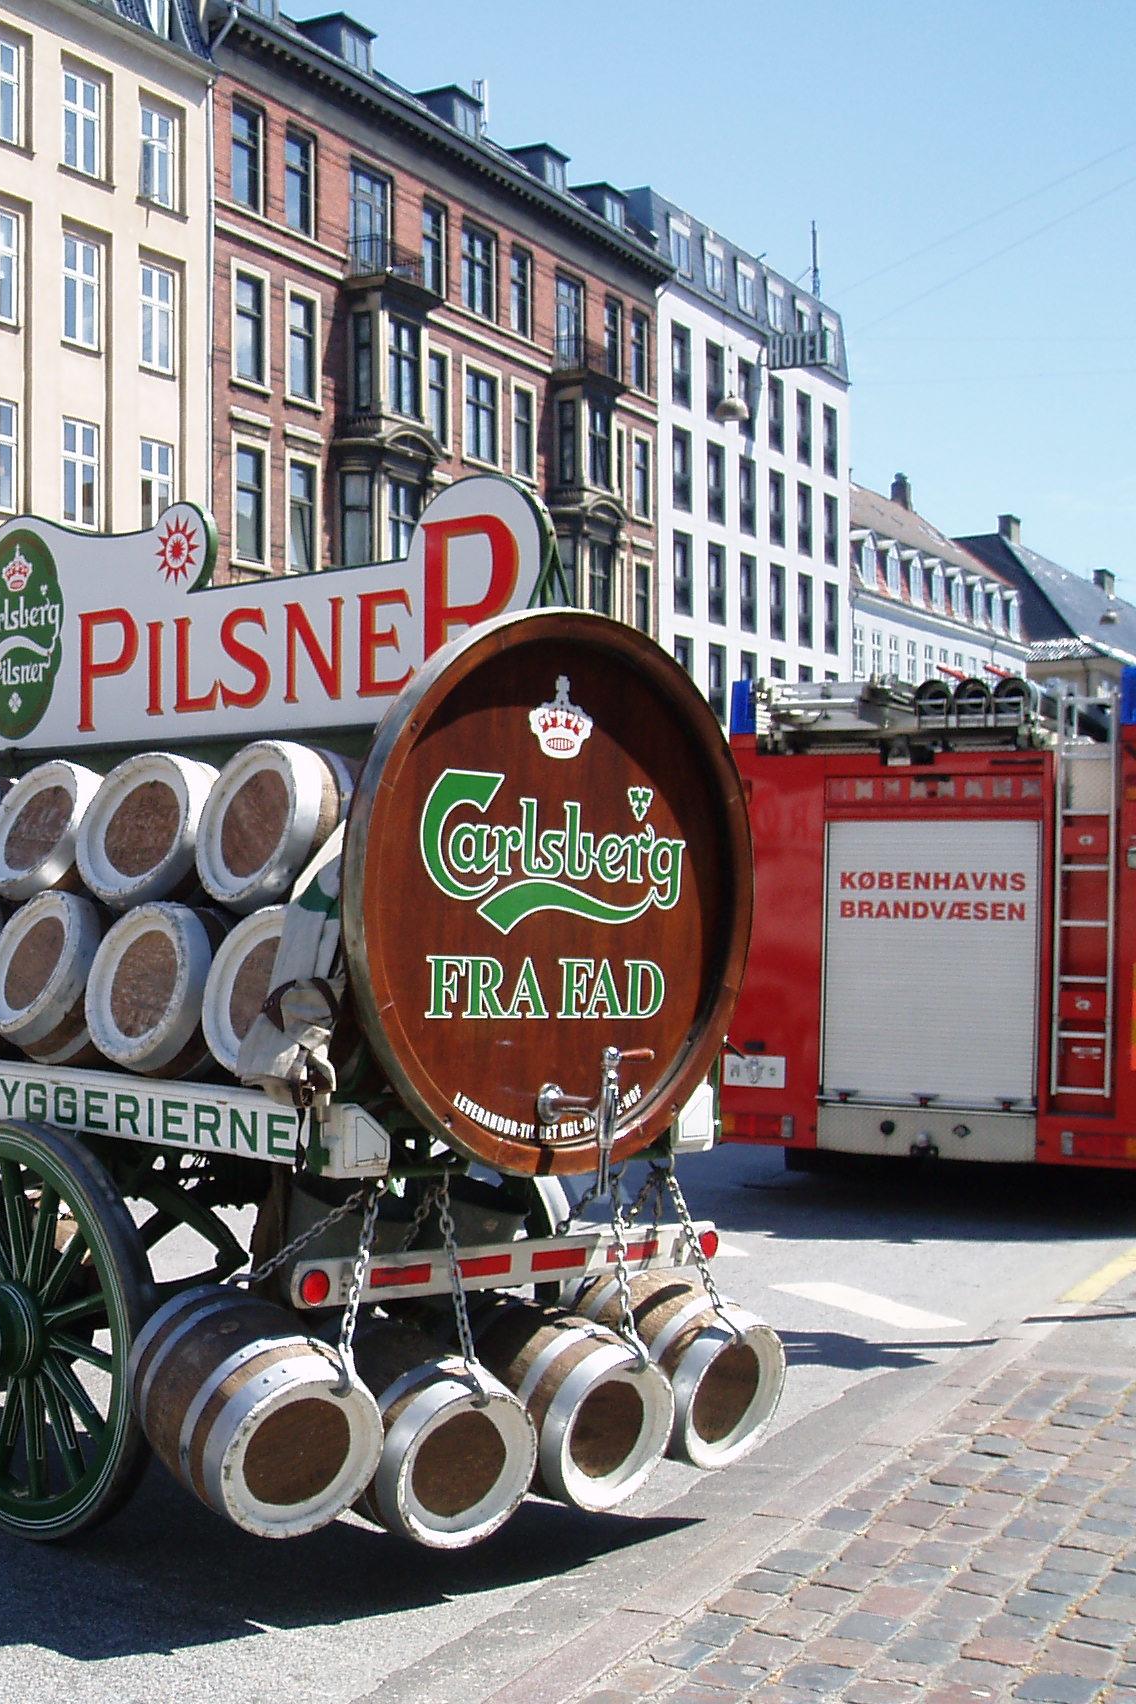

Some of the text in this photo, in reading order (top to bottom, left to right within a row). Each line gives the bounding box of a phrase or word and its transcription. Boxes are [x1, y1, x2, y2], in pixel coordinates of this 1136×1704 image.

[768, 332, 827, 369] HOTEL
[420, 768, 687, 910] Carlsberg
[840, 871, 1026, 891] KØBENHAVNS
[840, 901, 1026, 921] BRANDVÆSEN
[425, 955, 666, 1019] FRA FAD
